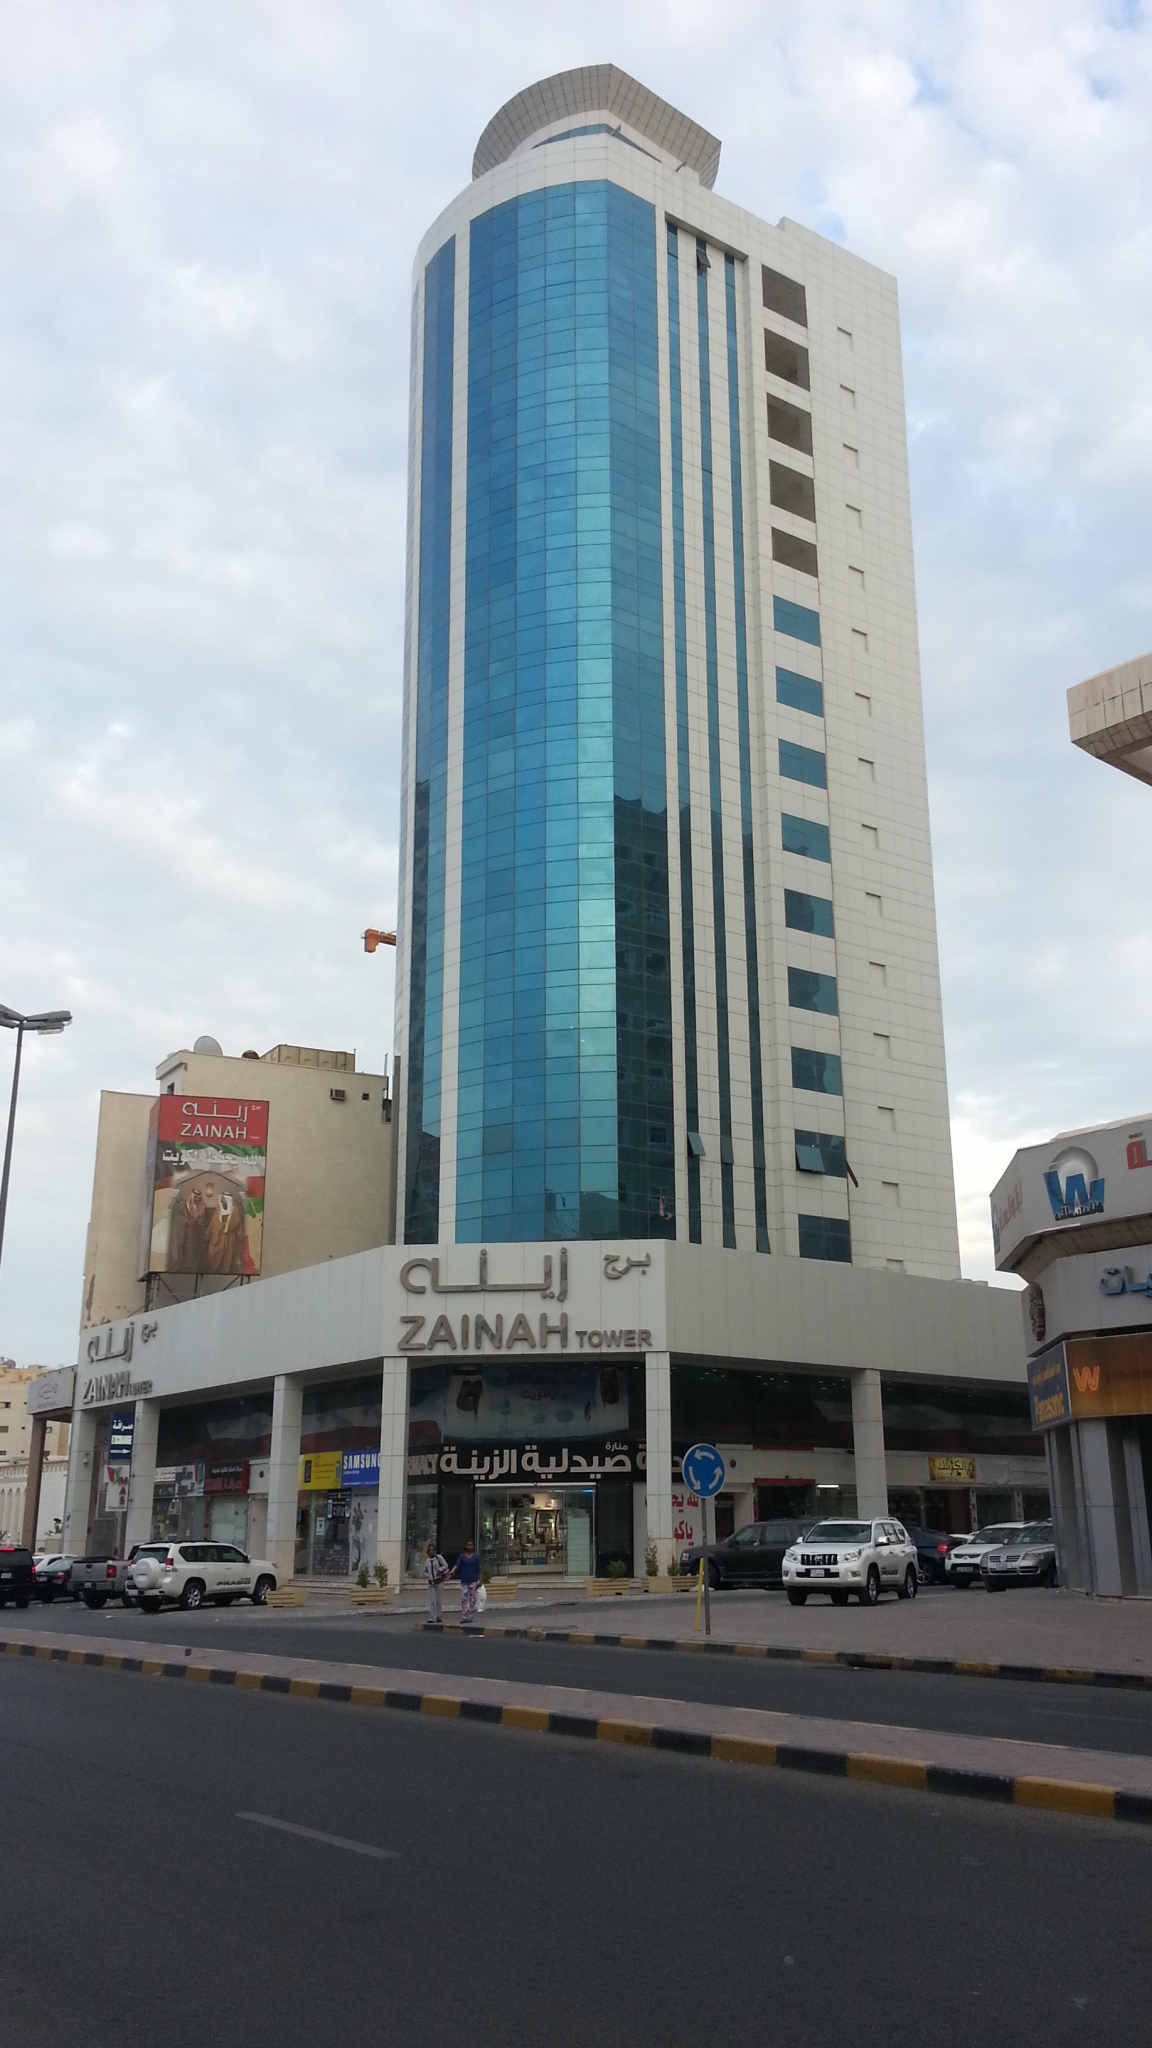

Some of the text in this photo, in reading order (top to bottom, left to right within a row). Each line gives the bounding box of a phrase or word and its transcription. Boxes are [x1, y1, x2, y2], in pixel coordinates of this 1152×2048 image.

[180, 1123, 247, 1140] ZAINAH
[603, 1252, 650, 1280] برج
[141, 1321, 158, 1343] برج
[397, 1312, 652, 1351] ZAINAH TOWER
[83, 1370, 131, 1405] ZAINAH
[605, 1441, 628, 1452] منارة
[439, 1445, 517, 1481] الزينة
[520, 1445, 631, 1480] صيدلية
